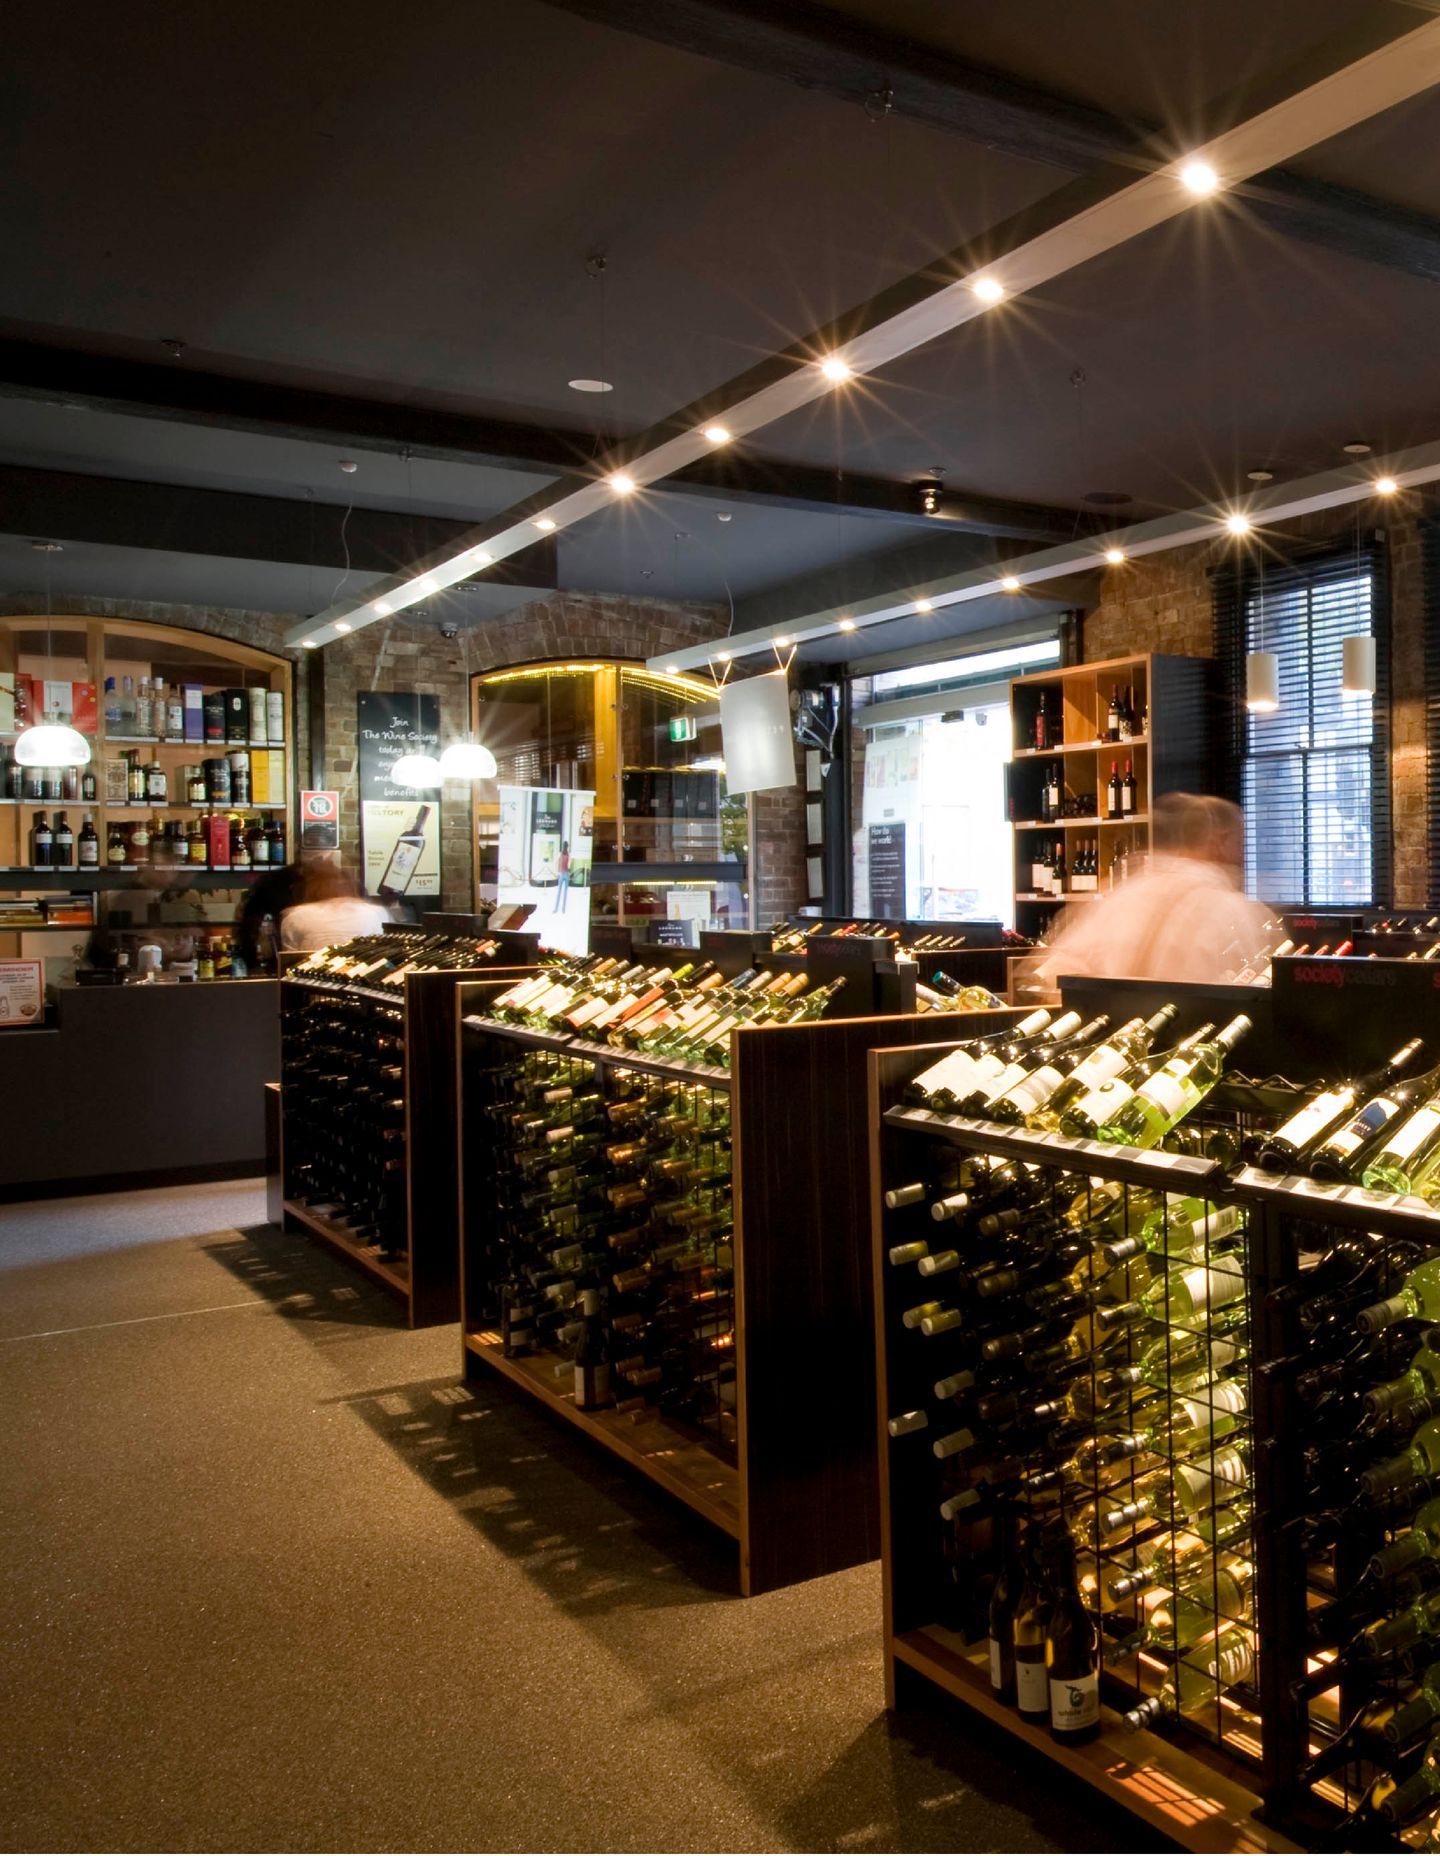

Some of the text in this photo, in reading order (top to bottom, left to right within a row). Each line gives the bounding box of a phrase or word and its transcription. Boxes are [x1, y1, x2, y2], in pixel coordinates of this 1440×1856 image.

[389, 717, 409, 728] Join
[362, 730, 438, 744] The Wine Society
[378, 745, 403, 757] today
